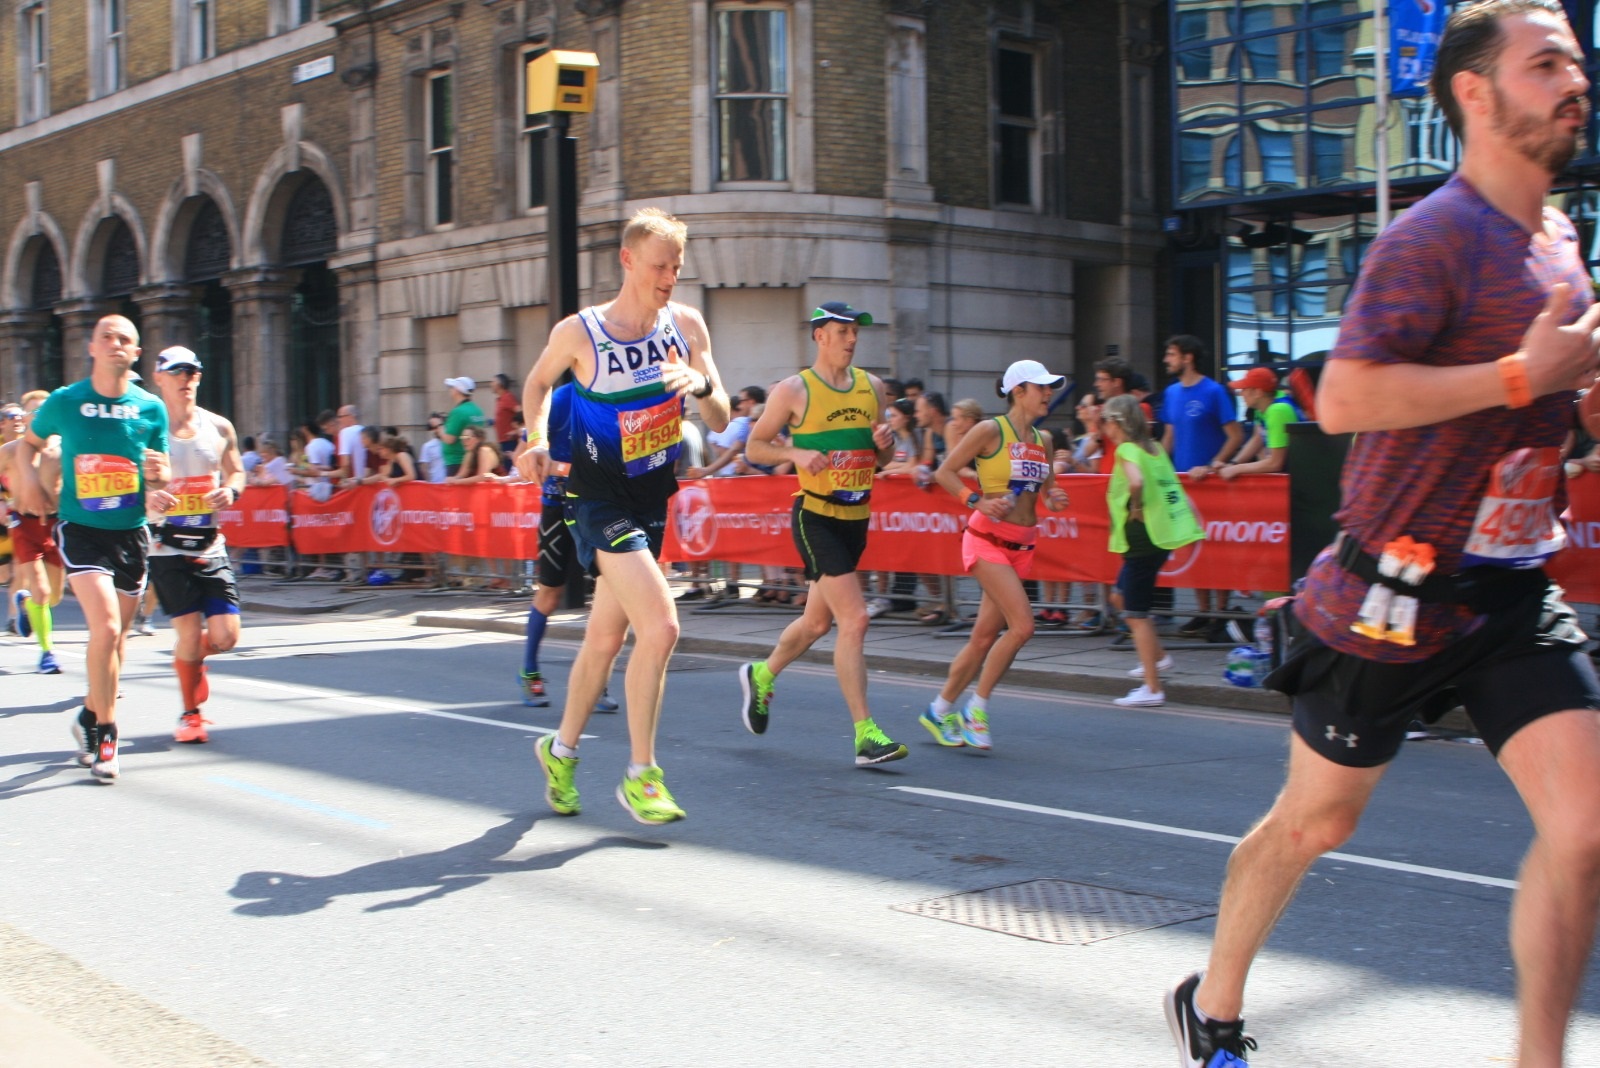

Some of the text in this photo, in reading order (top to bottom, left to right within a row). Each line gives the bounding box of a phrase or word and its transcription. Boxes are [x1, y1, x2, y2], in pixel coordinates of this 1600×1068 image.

[608, 336, 683, 376] ADAM
[633, 365, 660, 378] clapha
[80, 402, 140, 420] GLEN
[826, 407, 871, 422] CORNWALL
[843, 414, 857, 422] AC
[624, 411, 650, 434] Virgin
[624, 418, 680, 456] 31594
[831, 469, 872, 488] 32108
[1022, 461, 1042, 479] 551
[79, 472, 134, 494] 31762
[881, 512, 960, 533] LONDON
[1206, 520, 1290, 543] mone
